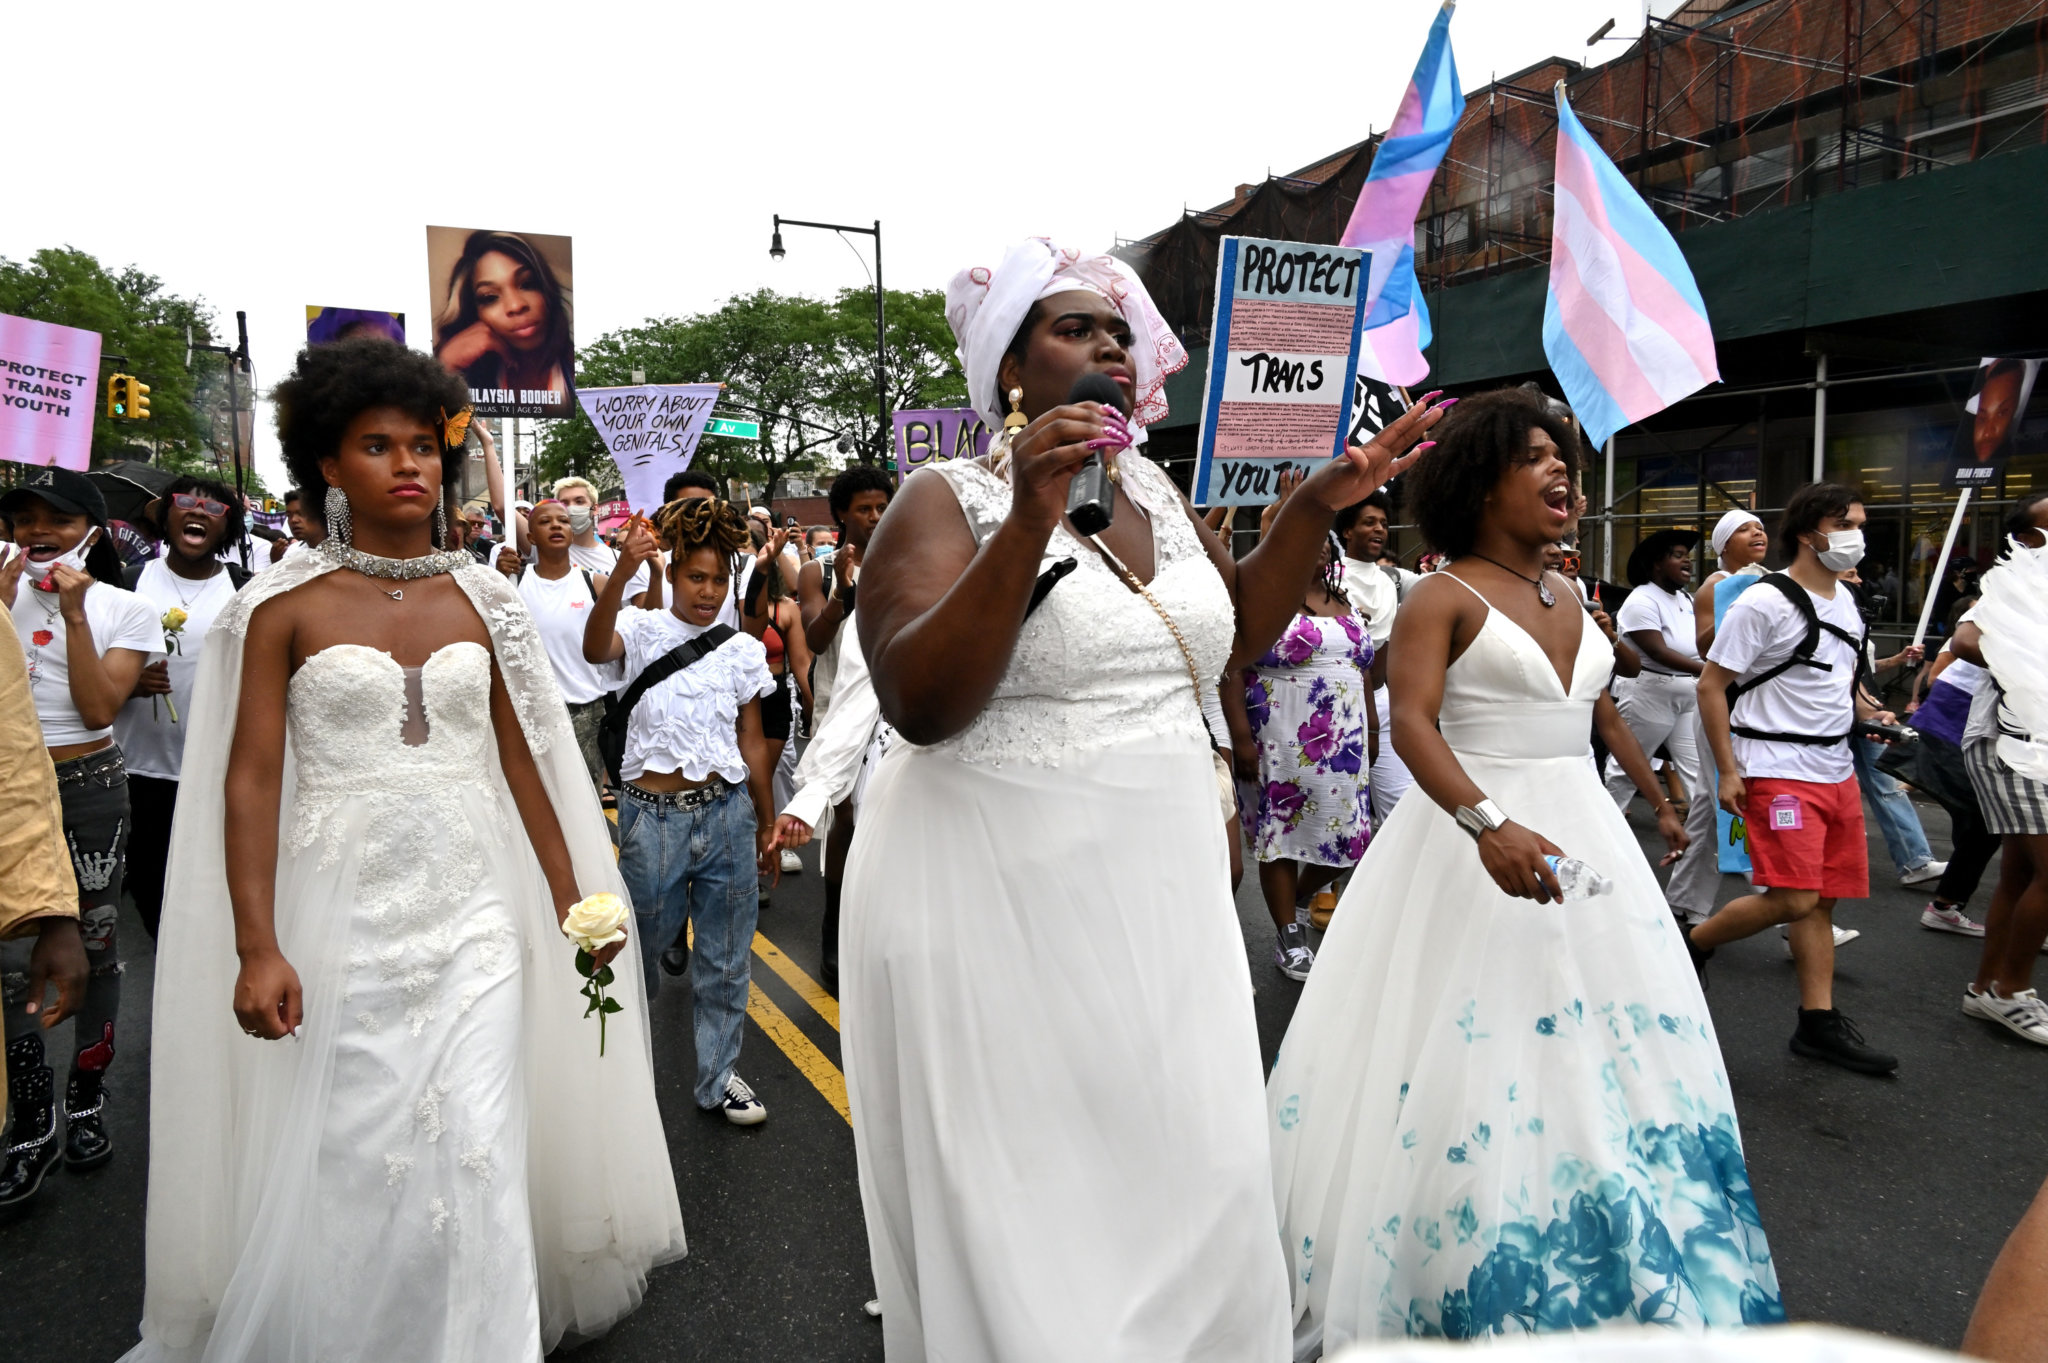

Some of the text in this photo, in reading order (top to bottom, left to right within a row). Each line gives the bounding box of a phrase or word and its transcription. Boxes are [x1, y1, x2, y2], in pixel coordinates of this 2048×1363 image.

[1242, 244, 1361, 298] PROTECT
[0, 359, 87, 387] PROTECT
[1240, 352, 1324, 393] TRANS
[5, 377, 72, 401] TRANS
[2, 393, 70, 417] YOUTH
[474, 405, 498, 413] ALLAS,
[595, 394, 712, 414] WORRY ABOUT
[602, 413, 693, 432] YOUR OWN
[707, 420, 736, 432] 7 Av
[612, 431, 695, 458] GENITALS!
[902, 419, 993, 466] BLAC
[29, 470, 54, 486] A
[118, 527, 151, 556] GIFTED
